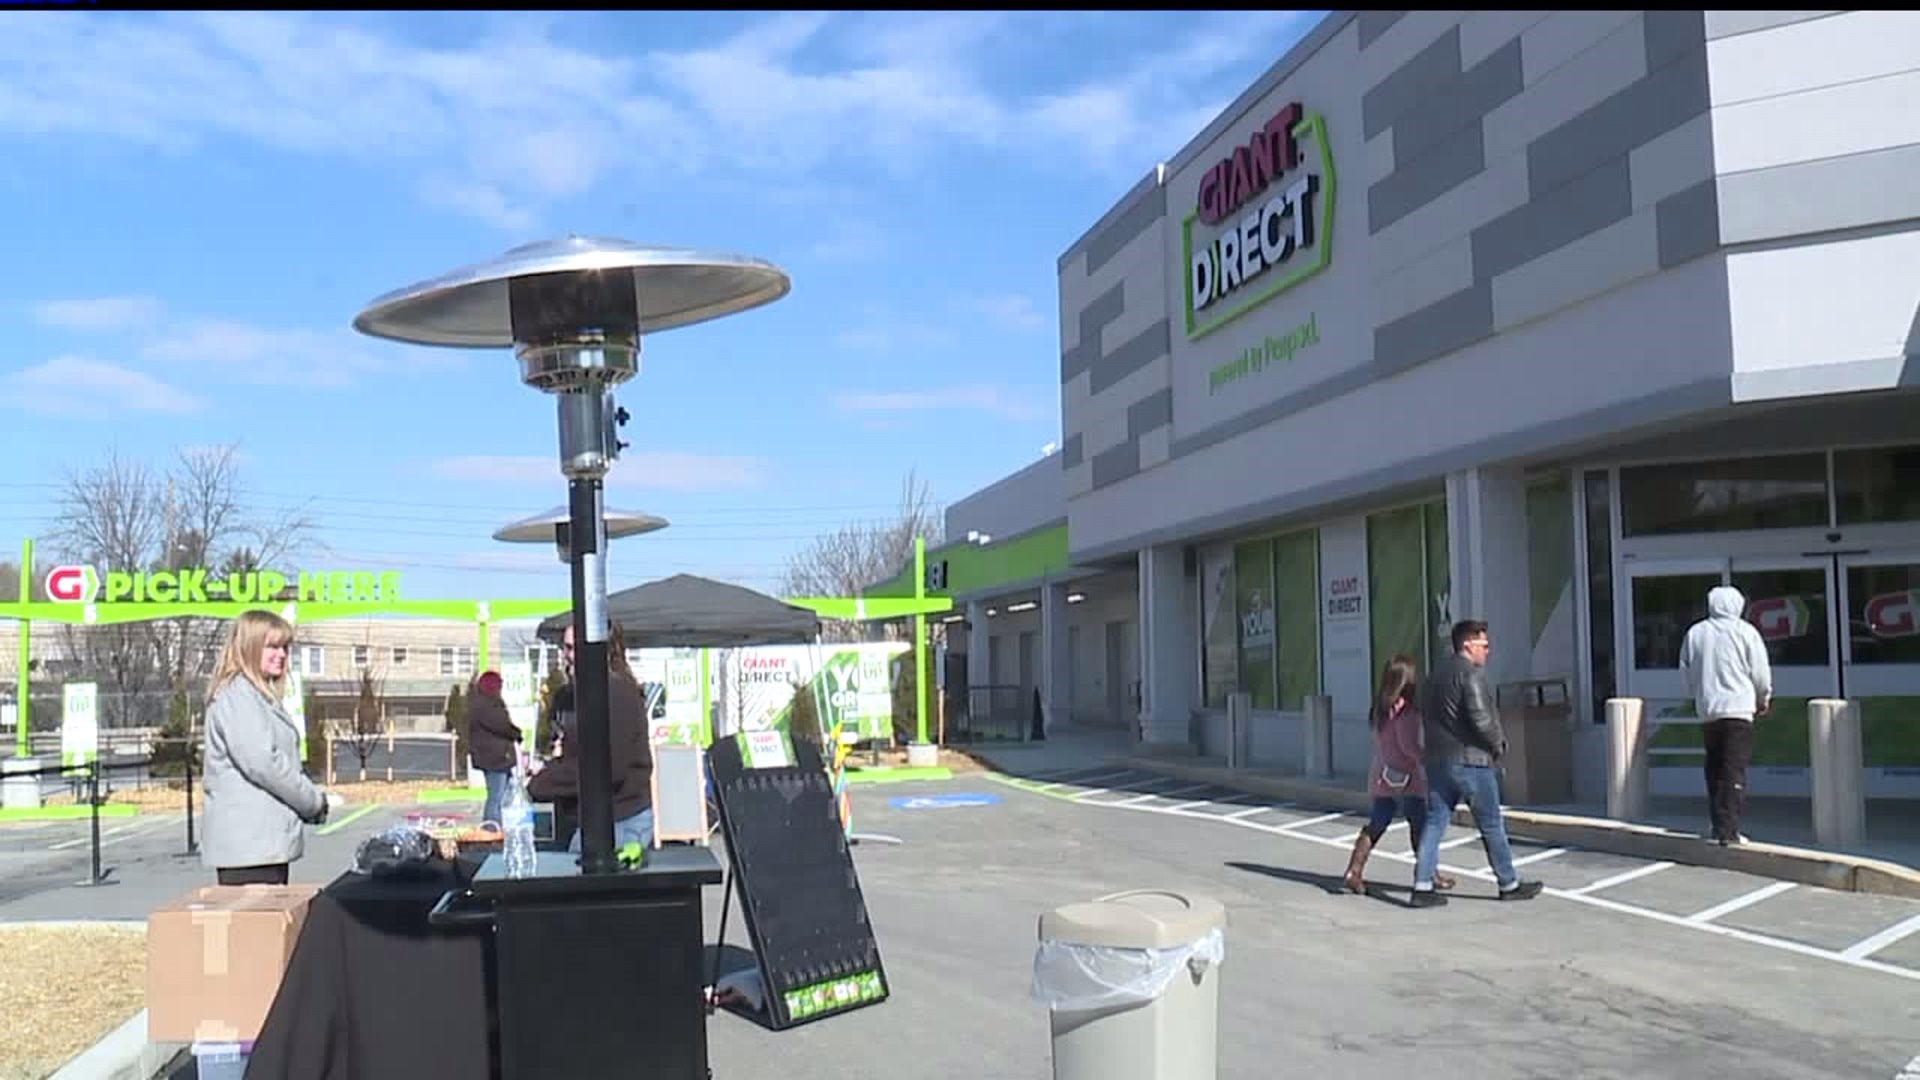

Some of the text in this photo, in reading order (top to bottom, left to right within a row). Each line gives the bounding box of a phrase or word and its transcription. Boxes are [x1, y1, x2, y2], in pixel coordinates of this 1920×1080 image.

[1193, 173, 1319, 311] DIRECT
[105, 568, 286, 602] PICK-UP
[298, 570, 402, 602] HERE
[1329, 597, 1361, 616] DIRECT
